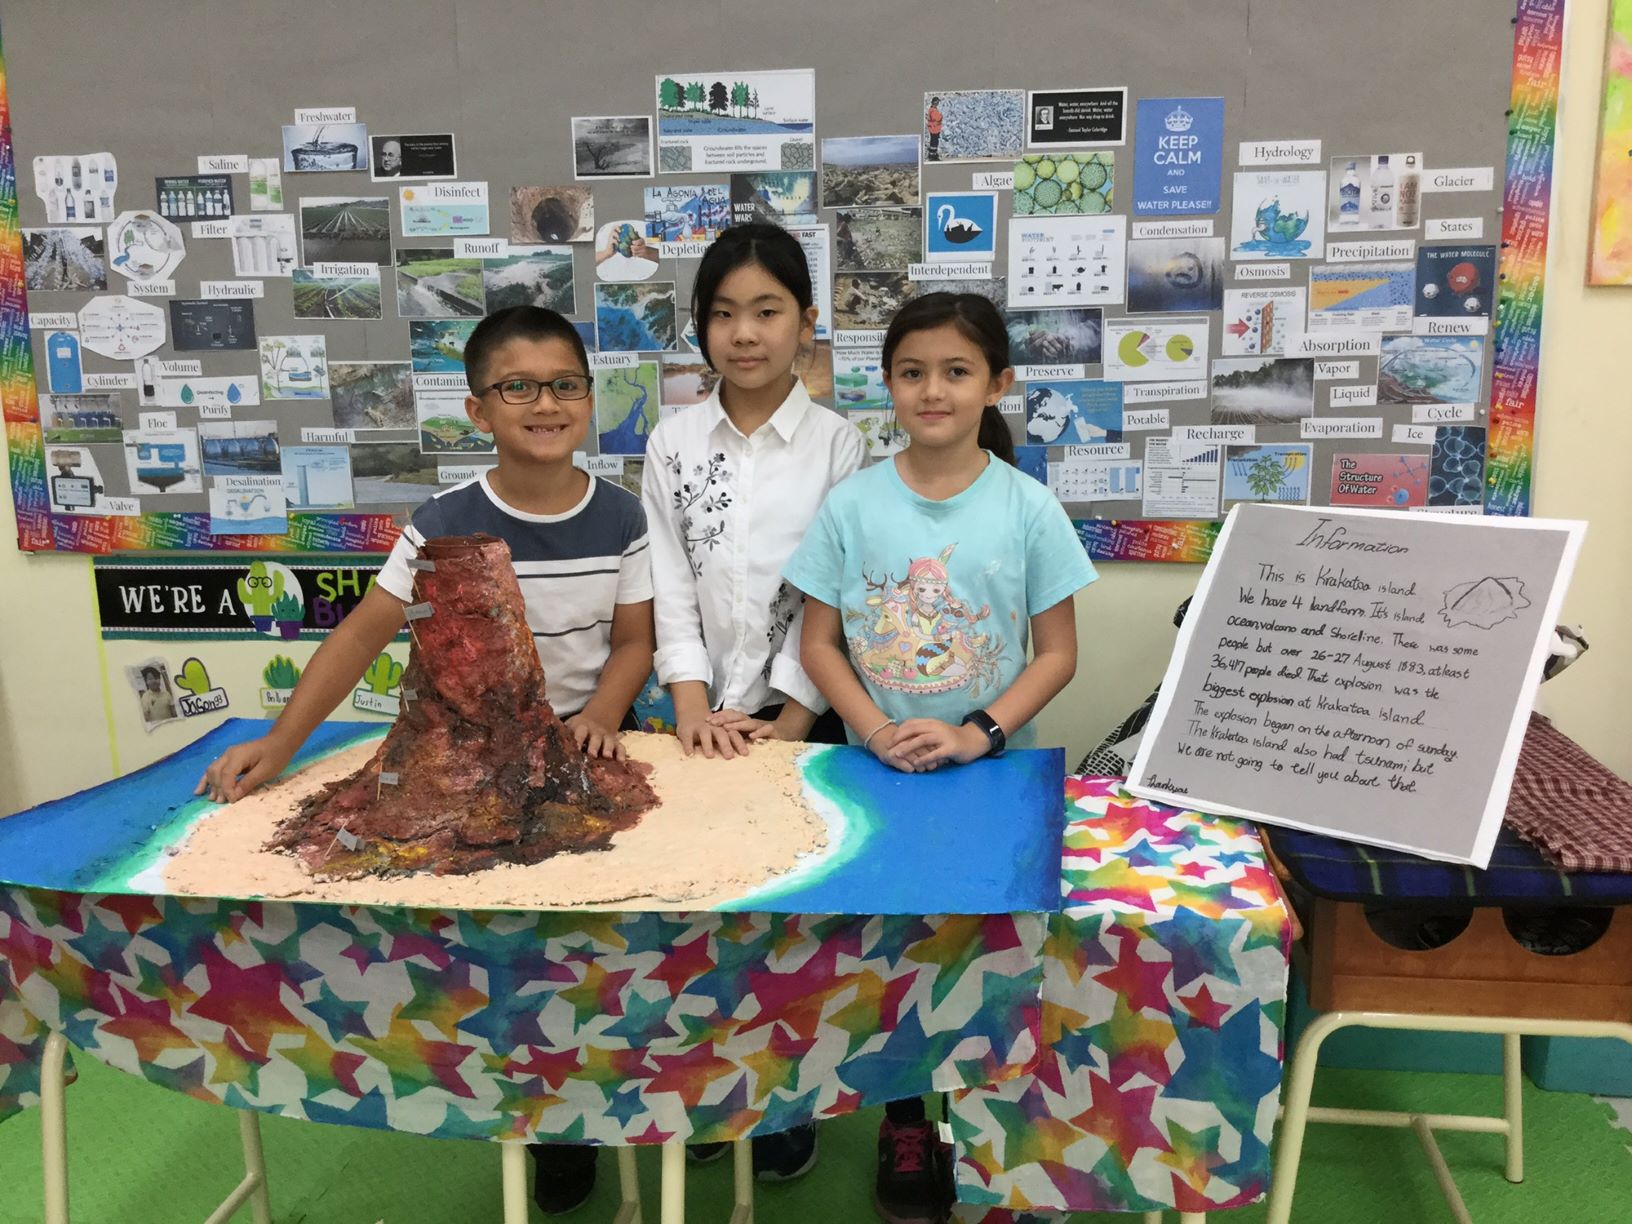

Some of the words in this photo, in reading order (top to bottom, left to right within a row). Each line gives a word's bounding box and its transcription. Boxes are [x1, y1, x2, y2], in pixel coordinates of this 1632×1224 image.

[299, 112, 352, 122] Freshwater
[1158, 135, 1198, 149] KEEP
[1153, 151, 1201, 165] CALM
[1253, 146, 1314, 160] Hydrology
[208, 159, 239, 170] Saline
[1166, 169, 1185, 177] AND
[981, 175, 1012, 187] Algae
[1433, 176, 1475, 187] Glacier
[434, 186, 481, 198] Disinfect
[1162, 185, 1188, 195] SAVE
[733, 203, 756, 212] WATER
[1137, 201, 1170, 210] WATER
[1171, 200, 1213, 209] PLEASE!!
[734, 213, 753, 223] WARS
[200, 224, 228, 235] Filter
[1139, 224, 1208, 236] Condensation
[1439, 221, 1473, 233] States
[464, 242, 500, 254] Runoff
[662, 243, 708, 257] Depletio
[1331, 245, 1410, 260] Precipitation
[1460, 250, 1490, 258] MOLECULE
[320, 264, 370, 278] Irrigation
[910, 264, 989, 278] Interdependent
[1240, 266, 1286, 277] Osmosis
[133, 283, 169, 296] System
[207, 284, 256, 297] Hydraulic
[30, 315, 72, 329] Capacity
[1428, 321, 1472, 334] Renew
[1299, 338, 1371, 353] Absorption
[592, 354, 632, 366] Estuary
[162, 362, 199, 373] Volume
[1025, 366, 1074, 378] Preserve
[1318, 363, 1351, 376] Vapor
[87, 375, 129, 388] Cylinder
[415, 375, 469, 387] Contamin
[1133, 386, 1200, 397] Transpiration
[1333, 387, 1370, 402] Liquid
[202, 405, 229, 416] Purify
[1427, 406, 1463, 419] Cycle
[147, 417, 168, 429] Floc
[1127, 412, 1167, 426] Potable
[1187, 427, 1245, 443] Recharge
[1304, 421, 1376, 436] Evaporation
[1407, 428, 1424, 440] Ice
[306, 431, 348, 443] Harmful
[1069, 444, 1124, 457] Resource
[587, 459, 618, 470] Inflow
[1340, 458, 1357, 469] The
[226, 476, 281, 487] Desalination
[1339, 472, 1383, 483] Structure
[1337, 483, 1350, 494] Of
[1350, 484, 1377, 495] Water
[109, 501, 135, 512] Valve
[1295, 518, 1409, 554] Information
[1258, 562, 1285, 583] This
[1295, 570, 1306, 584] is
[118, 584, 206, 614] WE'RE
[217, 589, 237, 616] A
[1239, 586, 1255, 605] We
[1261, 588, 1287, 608] have
[1292, 594, 1303, 609] 4
[1300, 623, 1327, 636] and
[1428, 644, 1449, 654] was
[1451, 646, 1479, 656] some
[1217, 636, 1249, 651] people
[1255, 637, 1273, 653] but
[1280, 648, 1303, 657] over
[1310, 649, 1351, 664] 26-27
[1352, 652, 1392, 673] August
[1244, 664, 1272, 678] people
[1306, 667, 1329, 684] That
[1334, 675, 1383, 692] explosion
[1394, 685, 1419, 697] was
[1201, 672, 1246, 699] biggest
[1297, 695, 1312, 710] at
[1316, 694, 1371, 716] Krakatoa
[355, 694, 382, 709] Justin
[1193, 699, 1209, 717] The
[1214, 707, 1258, 726] explosion
[1263, 710, 1295, 734] began
[1297, 725, 1312, 736] on
[1314, 724, 1330, 737] the
[1332, 727, 1391, 749] afternoon
[1395, 738, 1415, 751] of
[1187, 719, 1207, 737] The
[1209, 725, 1249, 744] Krakatoa
[1293, 742, 1318, 757] also
[1323, 743, 1350, 762] had
[1355, 750, 1410, 772] tsunami
[1411, 757, 1435, 775] but
[1177, 741, 1192, 756] We
[1194, 746, 1214, 758] are
[1215, 750, 1235, 762] not
[1235, 757, 1263, 772] going
[1269, 759, 1284, 772] to
[1290, 762, 1315, 775] tell
[1316, 770, 1339, 784] you
[1343, 769, 1380, 787] about
